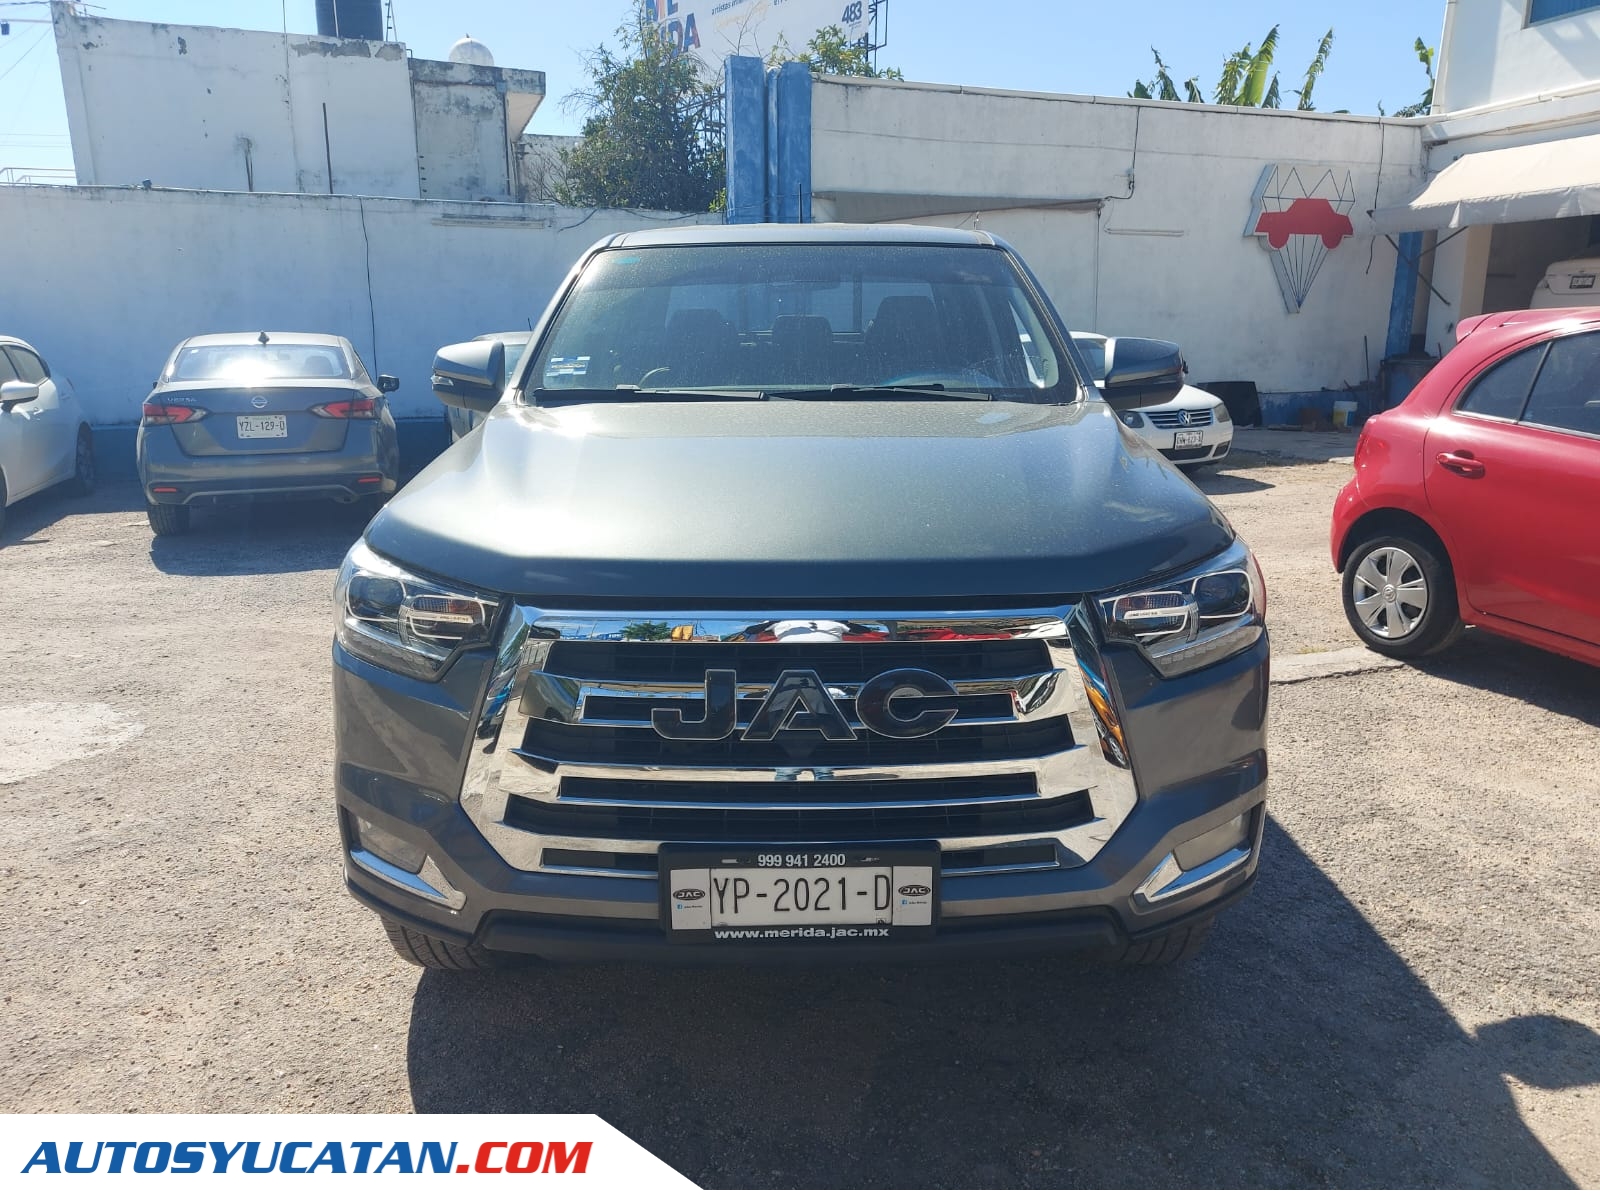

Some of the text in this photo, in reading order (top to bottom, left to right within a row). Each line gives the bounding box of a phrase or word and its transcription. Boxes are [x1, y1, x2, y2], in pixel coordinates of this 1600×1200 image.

[841, 1, 862, 23] 483
[651, 668, 960, 741] JAC
[757, 853, 846, 867] 999 941 2400
[713, 874, 891, 915] YP-2021-D
[714, 927, 889, 939] www.merida.jac.mx
